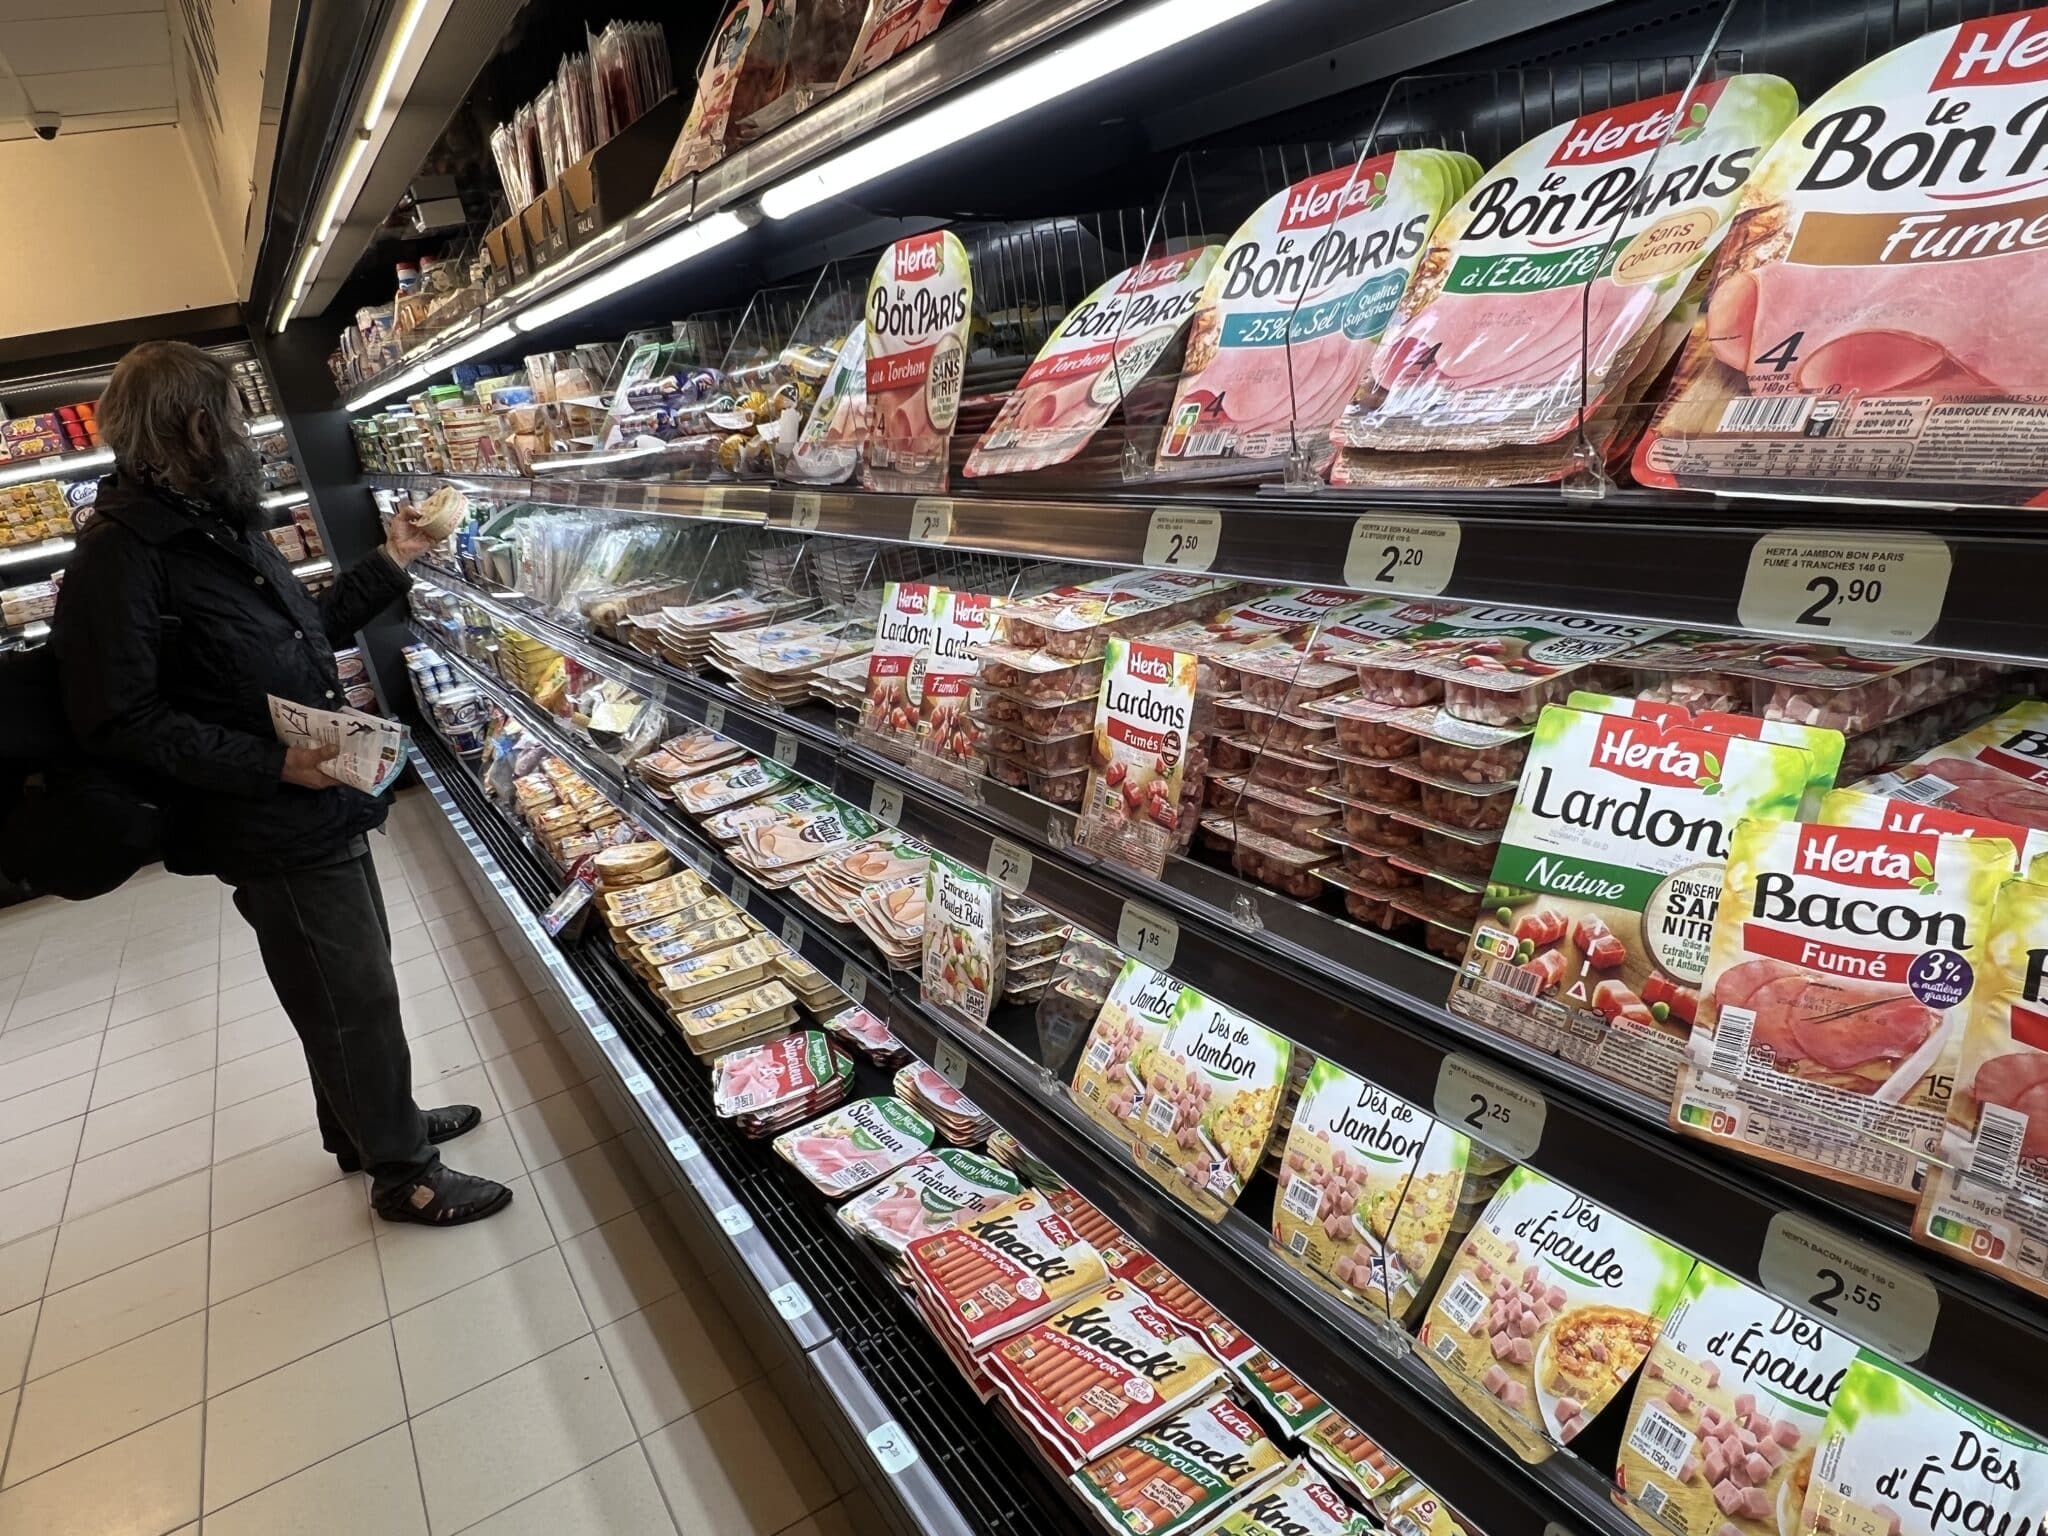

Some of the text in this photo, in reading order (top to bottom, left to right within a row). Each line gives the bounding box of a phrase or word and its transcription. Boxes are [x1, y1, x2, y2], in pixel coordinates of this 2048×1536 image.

[1926, 96, 1970, 127] le
[1561, 108, 1683, 161] Herta
[1796, 104, 1997, 192] Bon
[1460, 147, 1761, 242] Bon PARIS
[1539, 172, 1565, 192] le
[1286, 180, 1370, 225] Herta
[897, 243, 938, 274] Herta
[1221, 214, 1430, 300] Bon PARIS
[1277, 236, 1294, 255] le
[1121, 260, 1185, 291] Herta
[897, 285, 905, 301] le
[1107, 298, 1121, 309] le
[872, 286, 967, 336] Bon PARIS
[1061, 286, 1205, 338] Bon PARIS
[1238, 318, 1290, 343] -25%
[1050, 352, 1111, 374] Torchon
[1416, 343, 1443, 371] 4
[1755, 331, 1805, 372] 4
[888, 360, 925, 382] Torchon
[932, 360, 960, 383] SANS
[931, 378, 959, 398] NITRITE
[1205, 391, 1226, 417] 4
[878, 413, 885, 435] 4
[1932, 405, 1991, 416] FABRIQUÉ
[1992, 408, 2010, 416] EN
[1165, 534, 1198, 563] 2,50
[1375, 546, 1423, 583] 2,20
[1766, 548, 1905, 562] HERTA JAMBON BON PARIS
[1763, 559, 1790, 568] FUME
[1800, 561, 1855, 571] TRANCHES
[1858, 563, 1875, 572] 140
[1878, 564, 1887, 573] G
[898, 589, 924, 608] Herta
[956, 601, 984, 623] Herta
[1795, 576, 1882, 627] 2,90
[1131, 651, 1167, 679] Herta
[1105, 680, 1185, 729] Lardons
[1124, 729, 1159, 750] Fumés
[1600, 729, 1700, 779] Herta
[1803, 834, 1911, 882] Herta
[1525, 856, 1626, 900] Nature
[939, 889, 984, 929] Poulet Rôti
[1752, 872, 1974, 952] Bacon
[1137, 928, 1160, 952] 1,95
[1663, 944, 1692, 959] Extraits
[1666, 957, 1674, 966] et
[1800, 942, 1888, 978] Fumé
[1919, 952, 1962, 985] 3%
[1130, 985, 1174, 1019] Jambo
[1923, 990, 1959, 1004] grasses
[1209, 1011, 1250, 1046] Dés de
[1186, 1035, 1257, 1080] Jambon
[1356, 1083, 1413, 1124] Dés de
[1924, 1074, 1954, 1101] 15
[882, 1101, 925, 1137] Fleury Michon
[1464, 1093, 1511, 1130] 2,25
[848, 1104, 904, 1153] Supérieur
[1329, 1106, 1425, 1162] Jambon
[853, 1163, 872, 1178] SANS
[934, 1170, 945, 1180] le
[950, 1154, 1008, 1188] Fleury Michon
[877, 1186, 890, 1196] 4
[912, 1165, 967, 1201] Tranché
[964, 1192, 986, 1212] Fin
[1015, 1198, 1035, 1211] 10
[1562, 1194, 1601, 1233] Dés
[1044, 1217, 1073, 1247] Herta
[969, 1215, 1075, 1283] Knacki
[1513, 1210, 1624, 1290] d'Épaule
[1782, 1229, 1810, 1248] HERTA
[1810, 1243, 1842, 1264] BACON
[1887, 1282, 1896, 1290] G
[1100, 1286, 1124, 1301] 10
[1808, 1268, 1882, 1316] 2,55
[1135, 1306, 1168, 1337] Herta
[1769, 1304, 1824, 1351] Dés
[1043, 1331, 1123, 1378] 100% PUR PORC
[1054, 1306, 1187, 1382] Knacki
[1664, 1359, 1702, 1385] 22 11 22
[1706, 1322, 1847, 1407] d'Épaul
[1215, 1402, 1252, 1438] Herta
[1155, 1417, 1256, 1482] Knacki
[1651, 1450, 1670, 1471] 150g
[1950, 1430, 2021, 1491] Dés
[1164, 1449, 1222, 1489] POULET
[1421, 1500, 1437, 1514] 6
[1846, 1514, 1856, 1525] 11
[1862, 1522, 1875, 1535] 22
